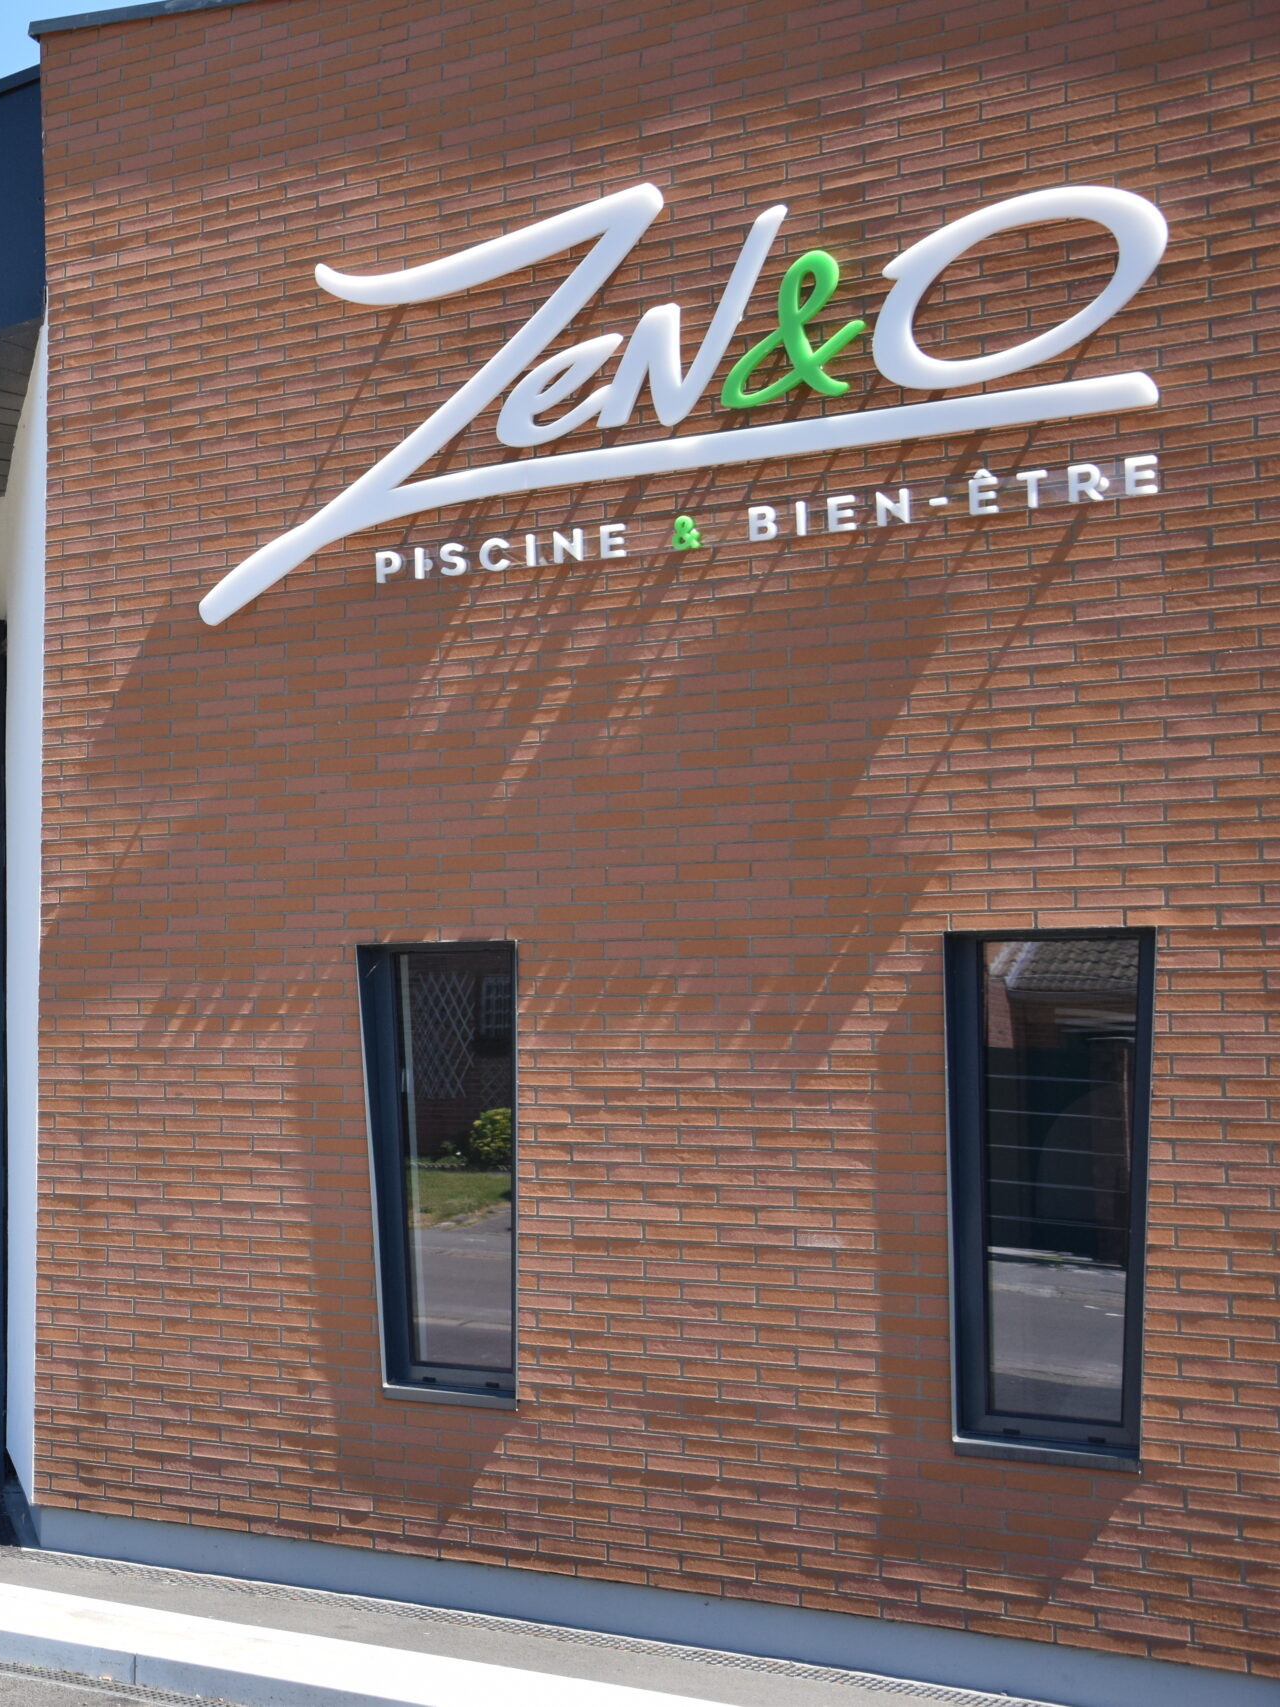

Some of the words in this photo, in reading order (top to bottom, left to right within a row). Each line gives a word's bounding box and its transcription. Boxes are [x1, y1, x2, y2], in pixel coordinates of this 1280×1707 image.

[375, 522, 628, 583] PISCINE
[671, 515, 702, 551] &
[747, 454, 1159, 542] BIEN-ÊTRE
